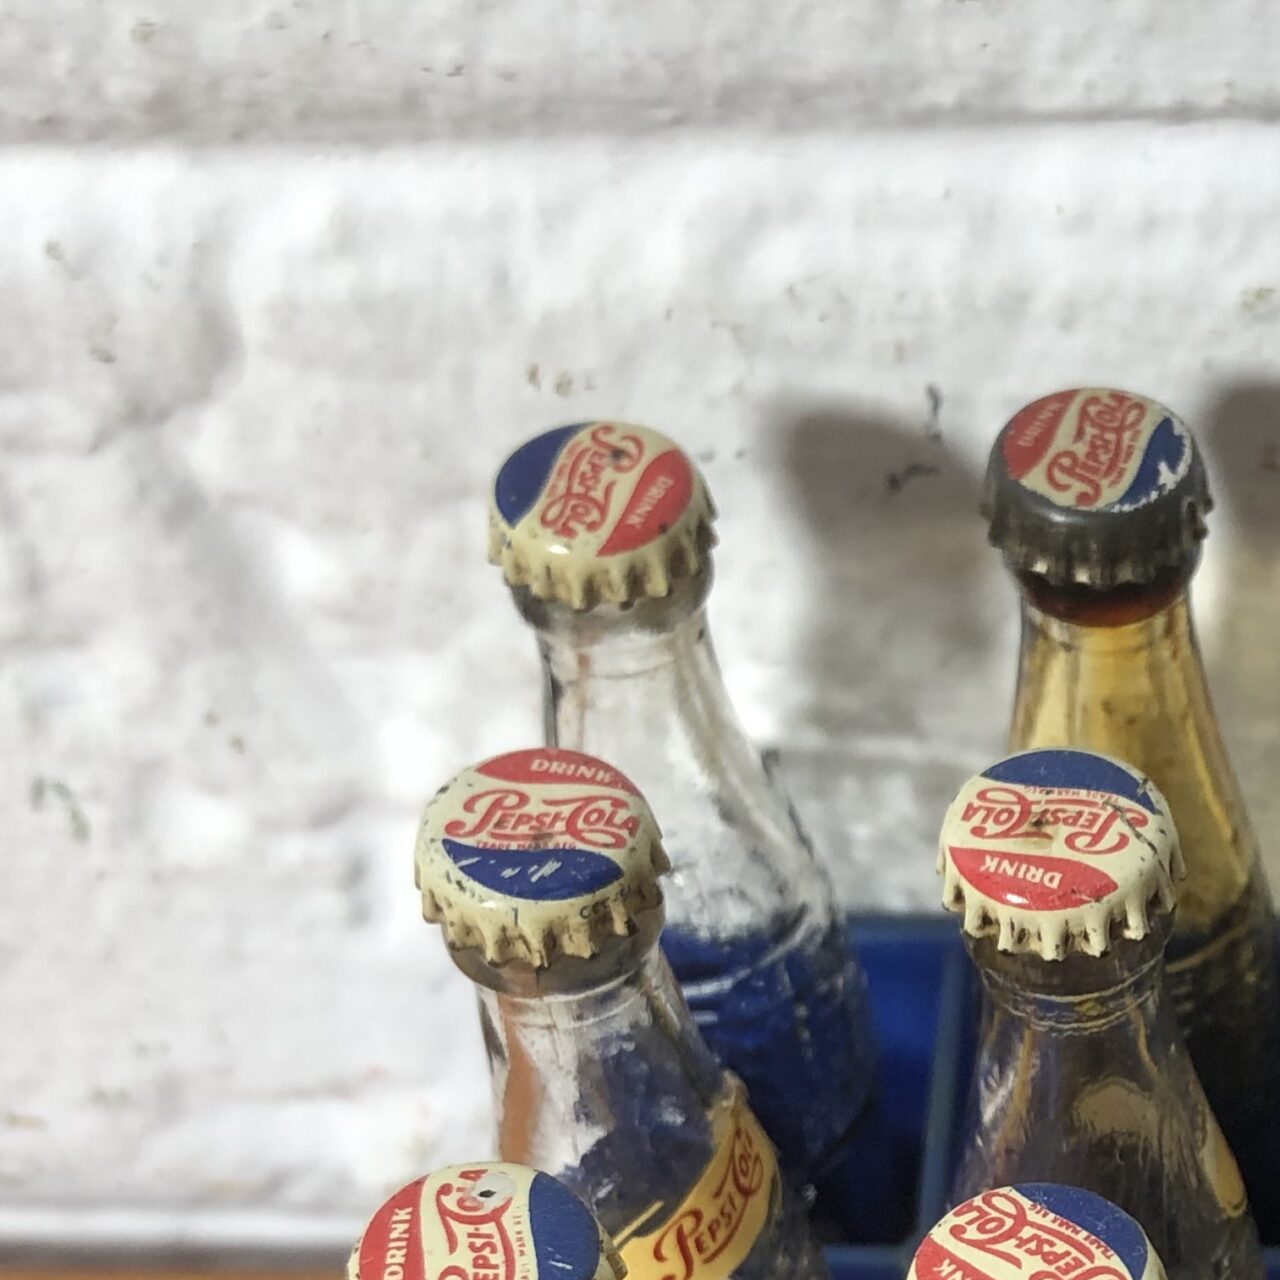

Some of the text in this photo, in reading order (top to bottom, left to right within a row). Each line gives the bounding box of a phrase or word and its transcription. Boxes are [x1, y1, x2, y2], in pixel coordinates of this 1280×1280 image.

[625, 475, 674, 528] DRINK
[530, 758, 616, 783] DRINK
[444, 789, 641, 849] PEPSI-COLA
[961, 787, 1149, 855] PEPSI-COLA
[980, 854, 1063, 890] DRINK
[1027, 1202, 1113, 1260] TRADE MARK REG
